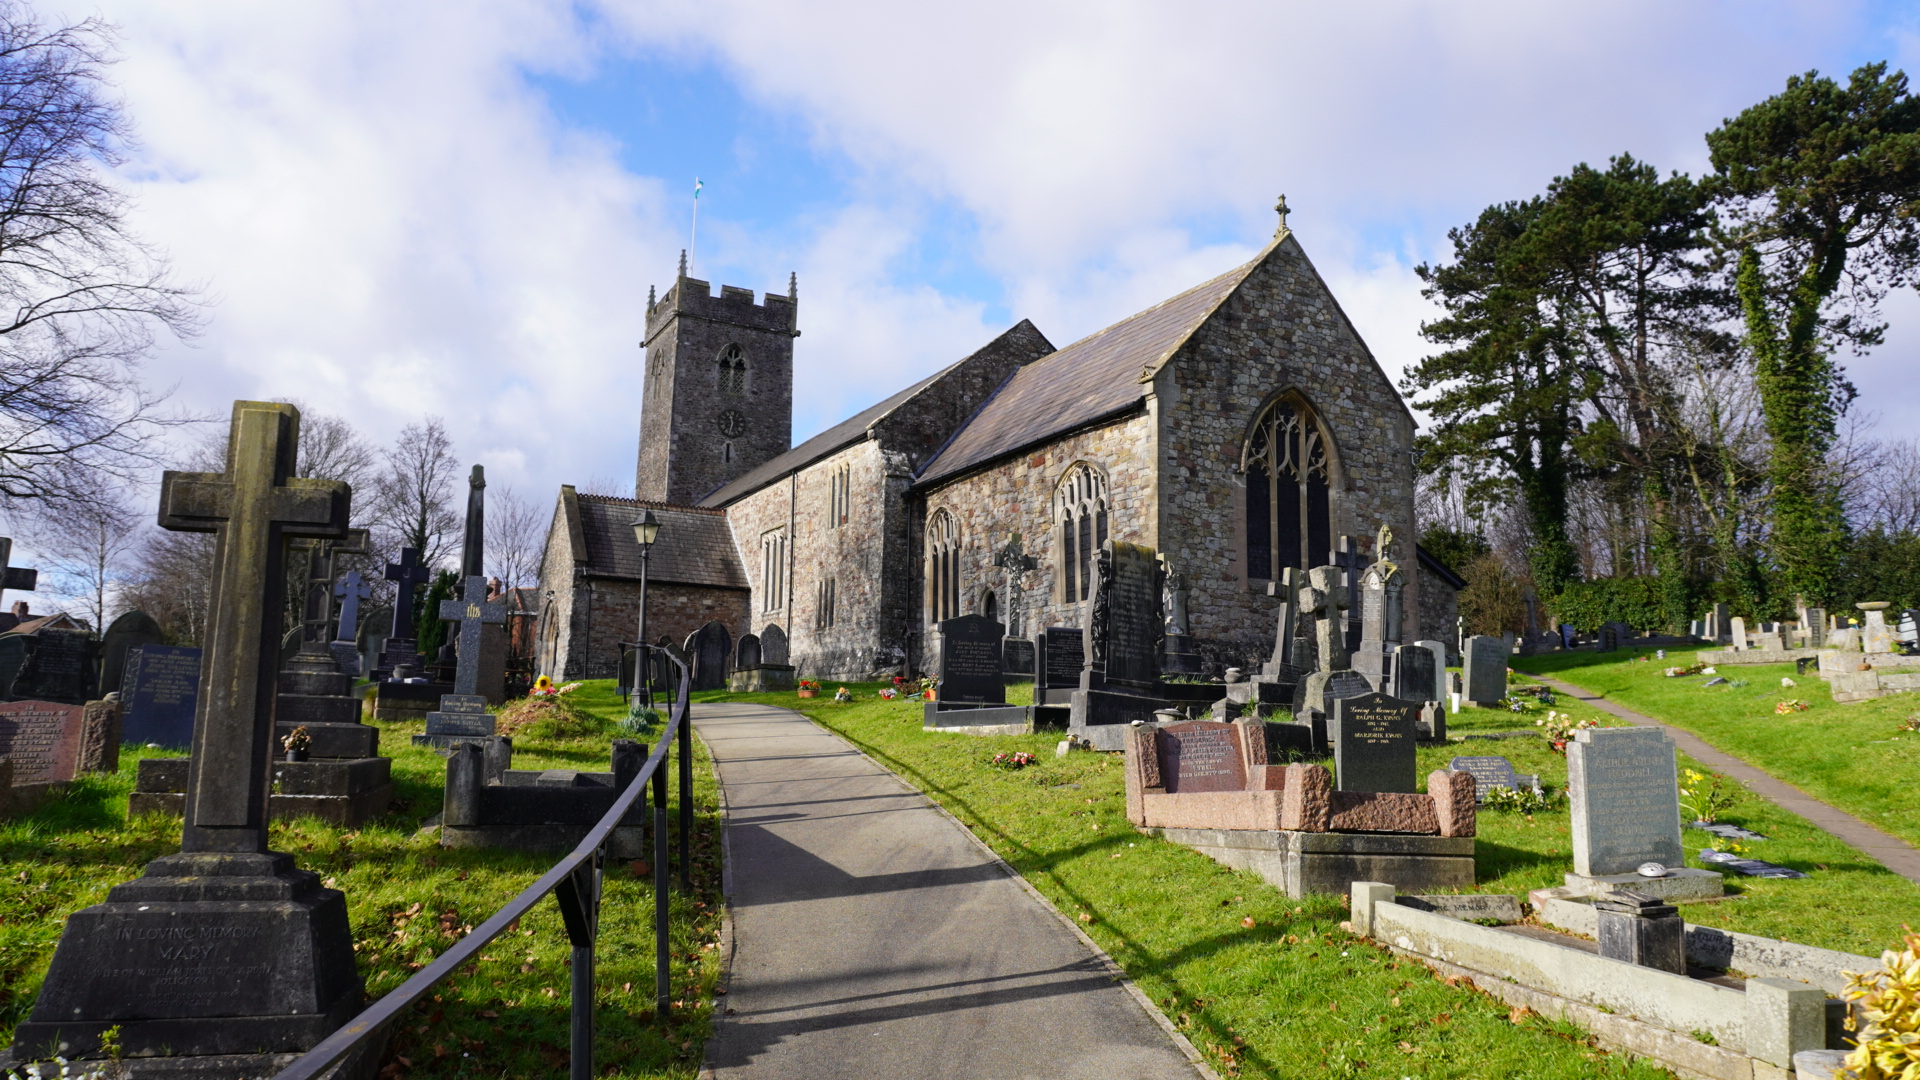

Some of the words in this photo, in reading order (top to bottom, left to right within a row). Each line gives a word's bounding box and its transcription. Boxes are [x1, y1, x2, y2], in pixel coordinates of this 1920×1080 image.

[1350, 706, 1370, 715] Loving
[1373, 706, 1398, 716] Memory
[1595, 757, 1628, 768] ARTHUR
[1454, 904, 1491, 912] MEMORY
[115, 927, 133, 940] IN
[200, 927, 260, 939] MEMORY
[159, 946, 214, 960] MARY
[95, 968, 118, 977] WIFE
[121, 968, 134, 976] OF
[137, 966, 183, 976] WILLIAM
[216, 966, 230, 975] OF
